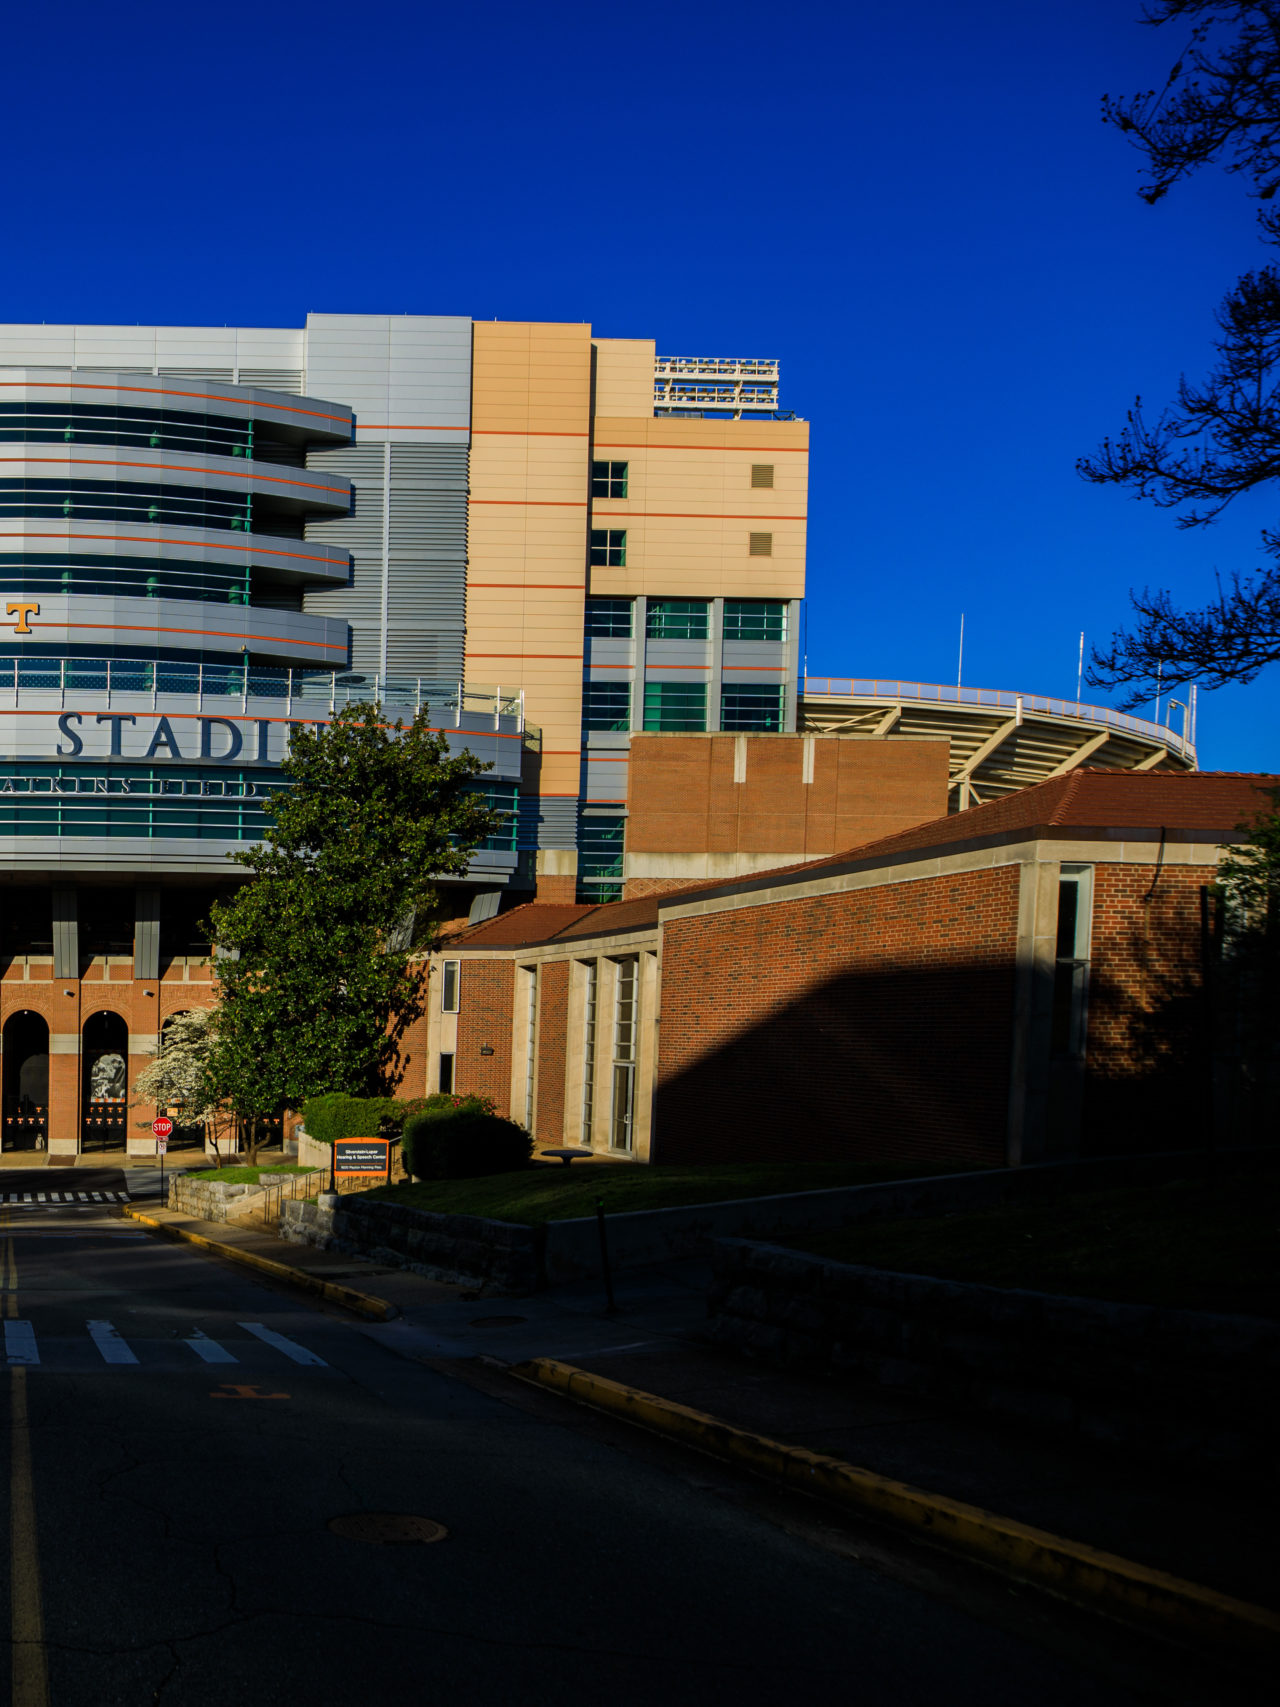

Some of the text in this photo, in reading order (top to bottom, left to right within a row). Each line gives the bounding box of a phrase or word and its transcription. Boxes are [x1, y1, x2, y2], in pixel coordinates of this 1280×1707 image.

[6, 603, 40, 634] T
[158, 779, 257, 798] FIELD
[153, 1123, 171, 1132] STOP
